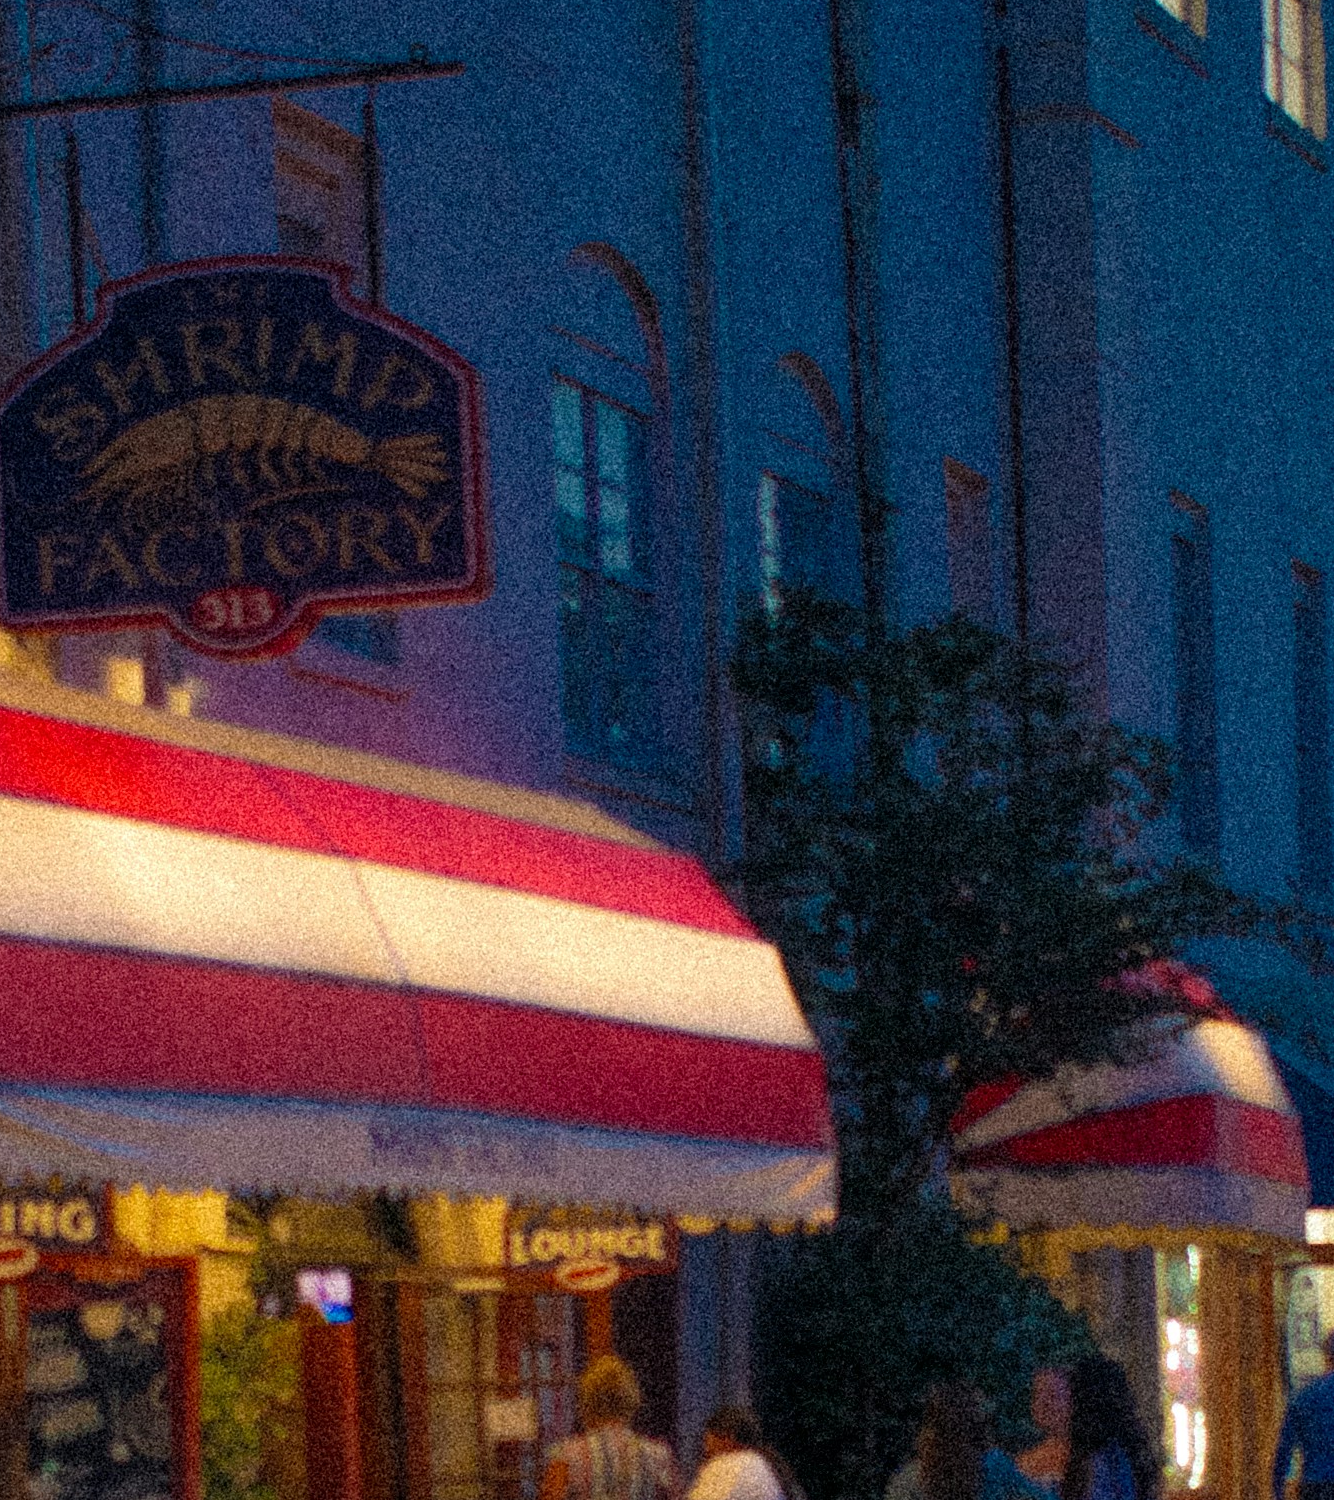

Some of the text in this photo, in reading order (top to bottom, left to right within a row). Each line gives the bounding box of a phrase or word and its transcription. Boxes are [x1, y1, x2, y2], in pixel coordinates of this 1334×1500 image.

[33, 317, 435, 460] SHRIMP
[38, 504, 450, 595] FACTORY
[200, 590, 274, 630] 313
[511, 1224, 665, 1263] LOUNGE
